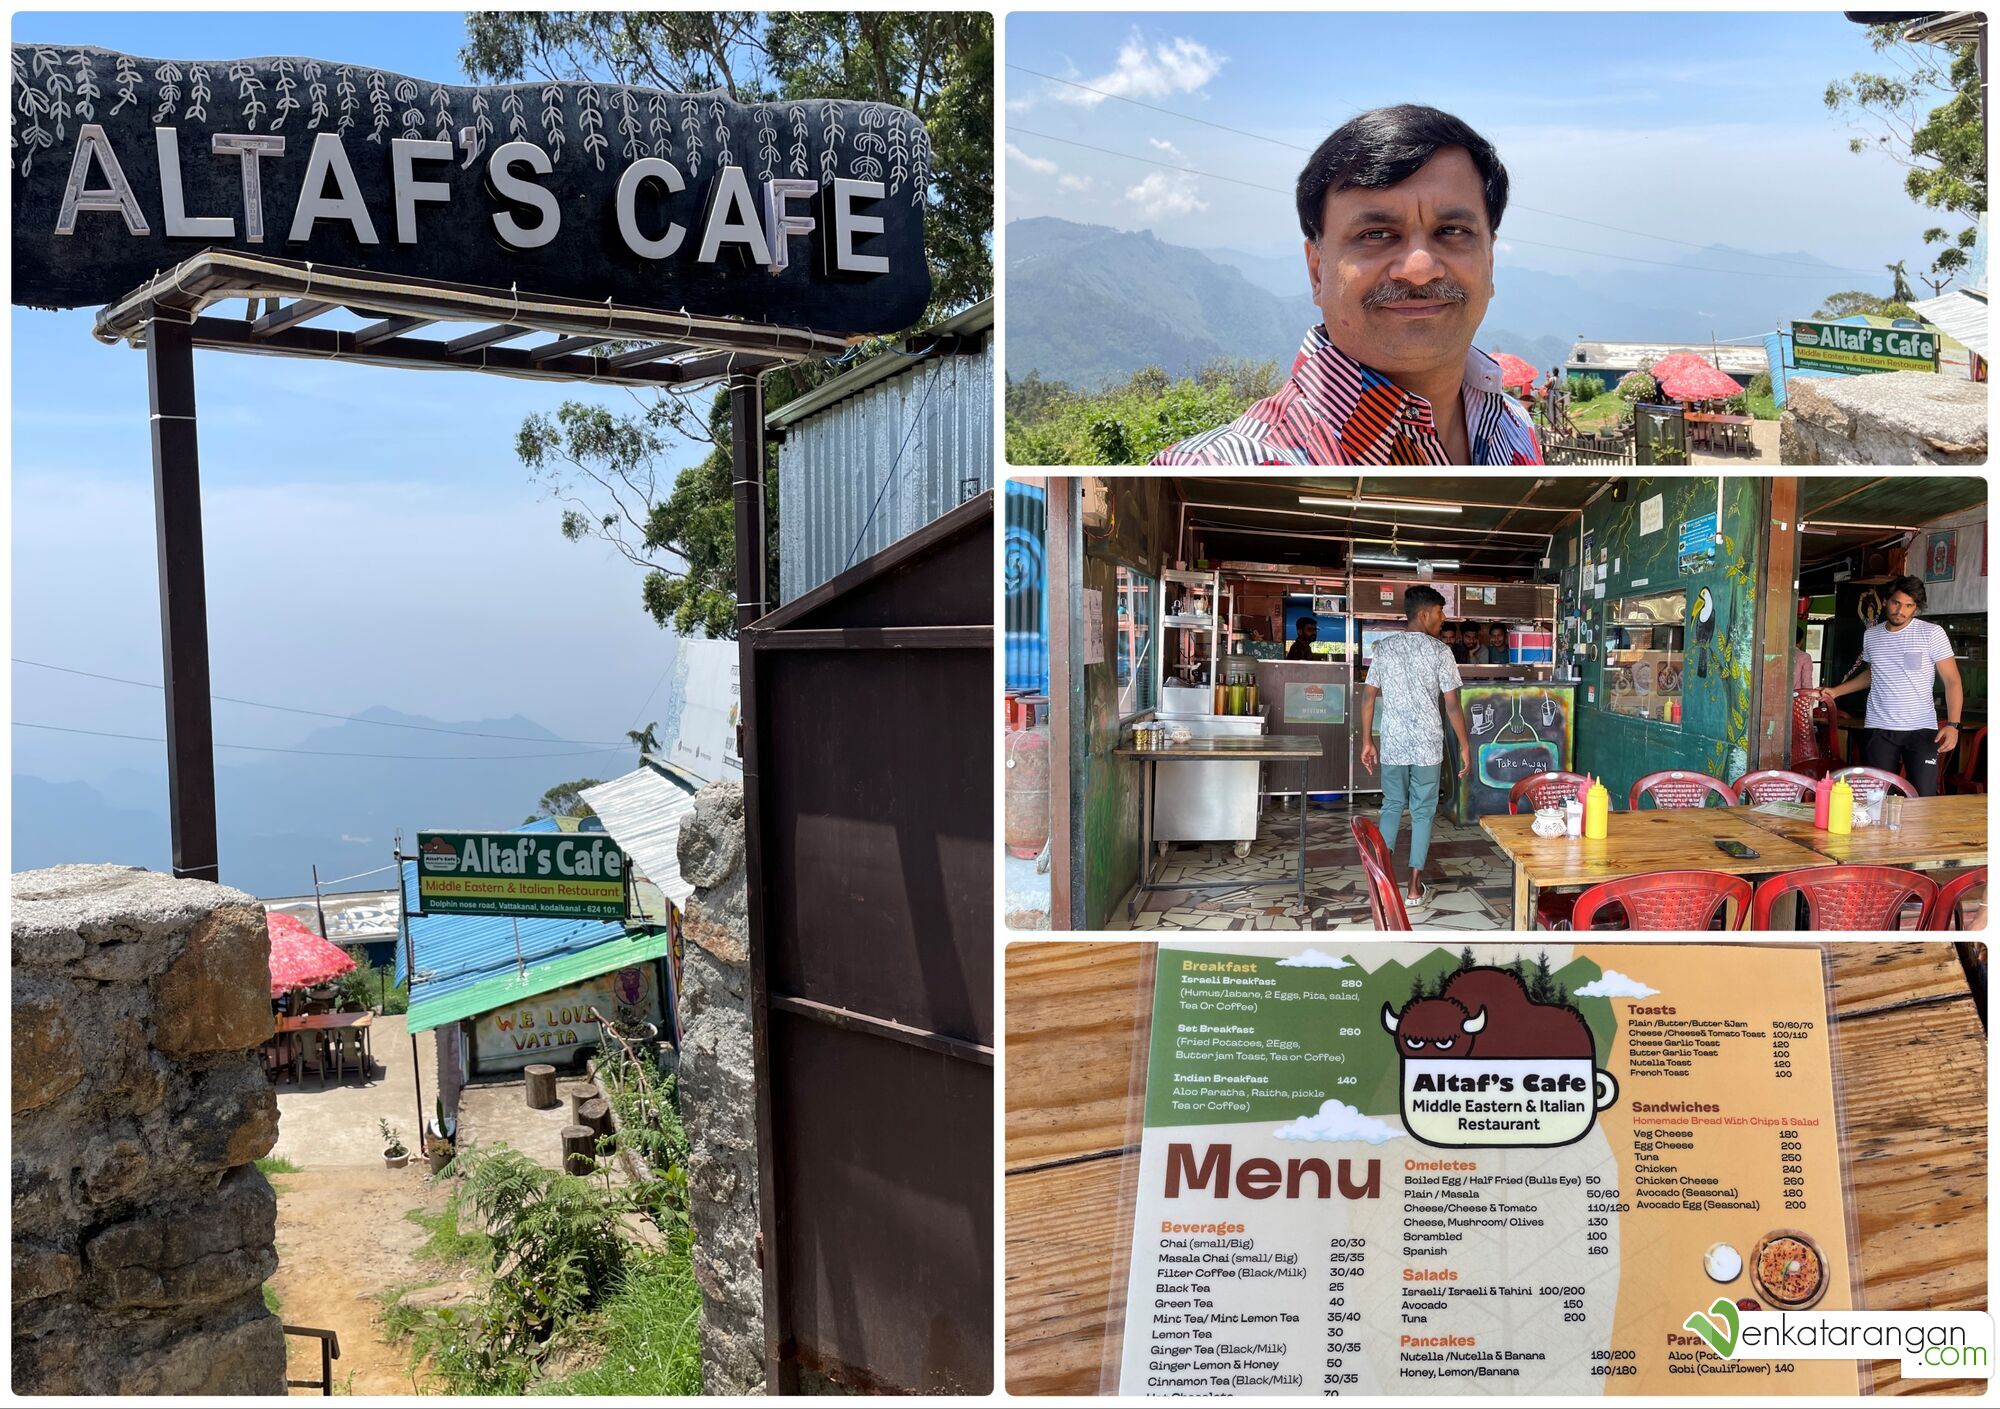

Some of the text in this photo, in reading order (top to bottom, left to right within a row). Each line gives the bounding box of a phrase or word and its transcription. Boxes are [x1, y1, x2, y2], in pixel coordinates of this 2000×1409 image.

[54, 124, 891, 275] ALTAF'S CAFE
[1820, 326, 1933, 358] Altaf's Cafe
[1797, 348, 1820, 358] Middle
[1822, 352, 1850, 362] Eastern
[1860, 356, 1885, 366] Italian
[1887, 359, 1932, 371] Restaurant
[1496, 759, 1547, 771] Take Away
[460, 838, 621, 877] Altaf's Cafe
[426, 880, 619, 897] Middle Eastern & Italian Restaurant
[430, 900, 457, 909] Dolphin
[479, 902, 497, 910] road,
[499, 902, 539, 912] Vattakanal,
[540, 904, 580, 913] kodaikanal
[587, 905, 600, 913] 624
[603, 906, 618, 914] 101.
[1183, 960, 1258, 973] Breakfast
[1181, 976, 1362, 988] Israeli Breakfast 280
[1628, 1004, 1676, 1015] Toasts
[495, 1004, 599, 1032] WE LOVE
[1178, 1025, 1361, 1036] Set Breakfast 260
[512, 1029, 578, 1050] VATTA
[1177, 1038, 1210, 1048] (Fried
[1212, 1039, 1265, 1048] Potatoes,
[1662, 1049, 1692, 1057] Garlic
[1173, 1074, 1211, 1082] Indian
[1213, 1075, 1269, 1084] Breakfast
[1413, 1074, 1586, 1092] Altaf's Cafe
[1413, 1099, 1585, 1113] Middle Eastern & Italian
[1632, 1101, 1720, 1113] Sandwiches
[1458, 1118, 1540, 1130] Restaurant
[1633, 1117, 1689, 1125] Homemade
[1691, 1117, 1722, 1125] Bread
[1724, 1117, 1748, 1125] With
[1750, 1118, 1779, 1127] Chips
[1790, 1118, 1819, 1126] Salad
[1634, 1130, 1798, 1139] Veg Cheese 180
[1634, 1141, 1801, 1151] Egg Cheese 200
[1634, 1153, 1801, 1162] Tuna 250
[1404, 1159, 1477, 1171] Omeletes
[1635, 1165, 1802, 1173] Chicken 240
[1164, 1143, 1381, 1200] Menu
[1404, 1176, 1600, 1187] Boiled Egg / Half Fried (Bulls Eye) 50
[1636, 1177, 1804, 1185] Chicken Cheese 260
[1404, 1190, 1620, 1200] Plain / Masala 50/60
[1636, 1188, 1803, 1199] Avocado (Seasonal) 180
[1404, 1203, 1630, 1213] Cheese/Cheese & Tomato 110/120
[1161, 1221, 1245, 1236] Beverages
[1403, 1232, 1607, 1241] Scrambled 100
[1160, 1238, 1366, 1250] Chai (small/Big) 20/30
[1403, 1247, 1608, 1257] Spanish 160
[1158, 1253, 1365, 1265] Masala Chai (small/ Big) 25/35
[1157, 1268, 1365, 1280] Filter Coffee (Black/Milk) 30/40
[1403, 1269, 1458, 1281] Salads
[1156, 1283, 1344, 1293] Black Tea 25
[1402, 1286, 1585, 1297] Israeli/ Israeli & Tahini 100/200
[1155, 1298, 1344, 1308] Green Tea 40
[1401, 1300, 1583, 1310] Avocado 150
[1401, 1313, 1586, 1323] Tuna 200
[1152, 1328, 1344, 1340] Lemon Tea 30
[1400, 1335, 1475, 1347] Pancakes
[1400, 1350, 1636, 1362] Nutella /Nutella & Banana 180/200
[1668, 1351, 1693, 1360] Aloo
[1669, 1363, 1794, 1376] Gobi (Cauliflower) 140
